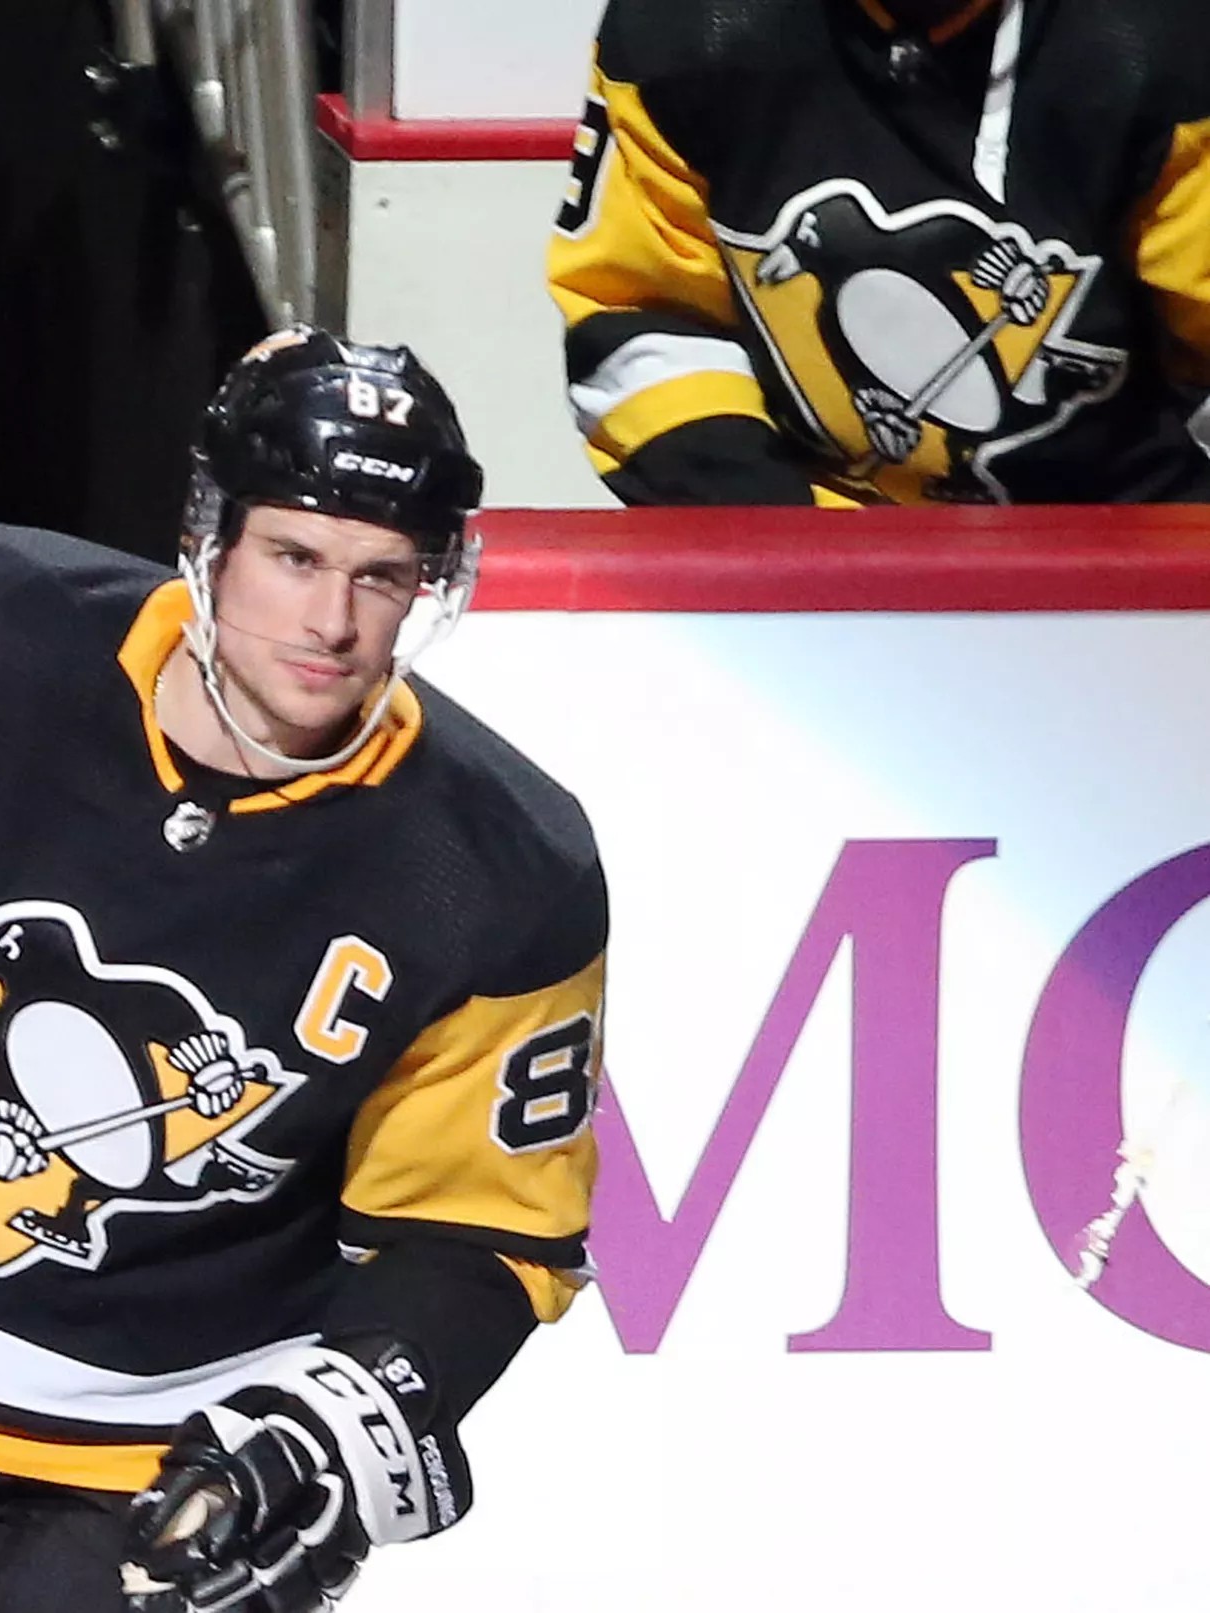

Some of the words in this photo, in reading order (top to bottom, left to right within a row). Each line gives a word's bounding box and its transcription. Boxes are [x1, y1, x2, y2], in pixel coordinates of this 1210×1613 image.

[348, 379, 415, 428] 87
[333, 452, 415, 482] CCM
[293, 934, 394, 1065] C
[385, 1357, 426, 1394] 87
[305, 1359, 416, 1517] CCM
